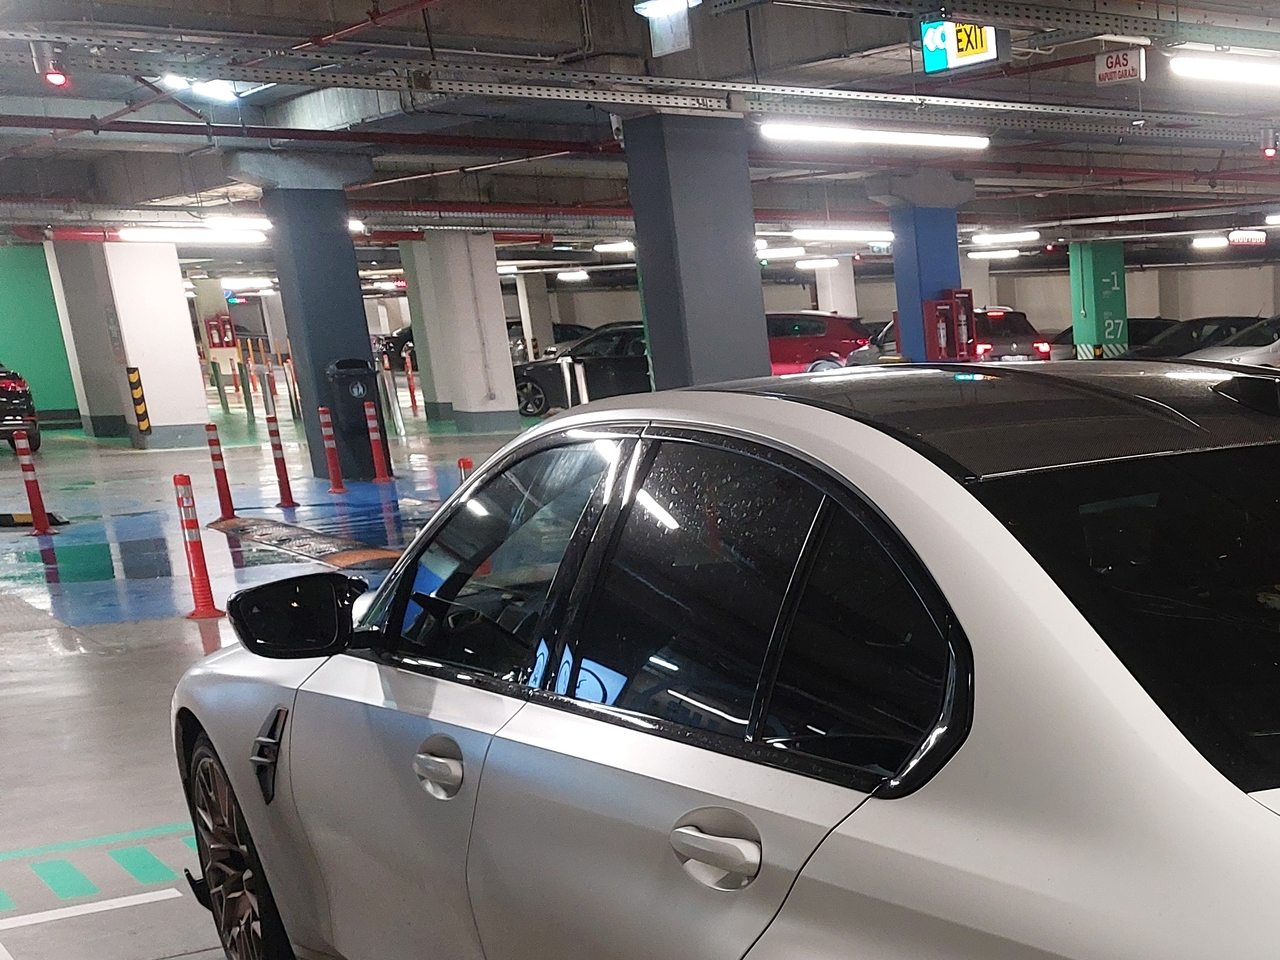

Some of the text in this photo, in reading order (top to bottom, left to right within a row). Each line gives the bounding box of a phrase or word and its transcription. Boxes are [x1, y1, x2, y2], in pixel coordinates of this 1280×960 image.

[956, 25, 984, 53] EXIT
[1105, 52, 1129, 70] GAS
[1101, 270, 1121, 291] -1
[1104, 319, 1125, 339] 27
